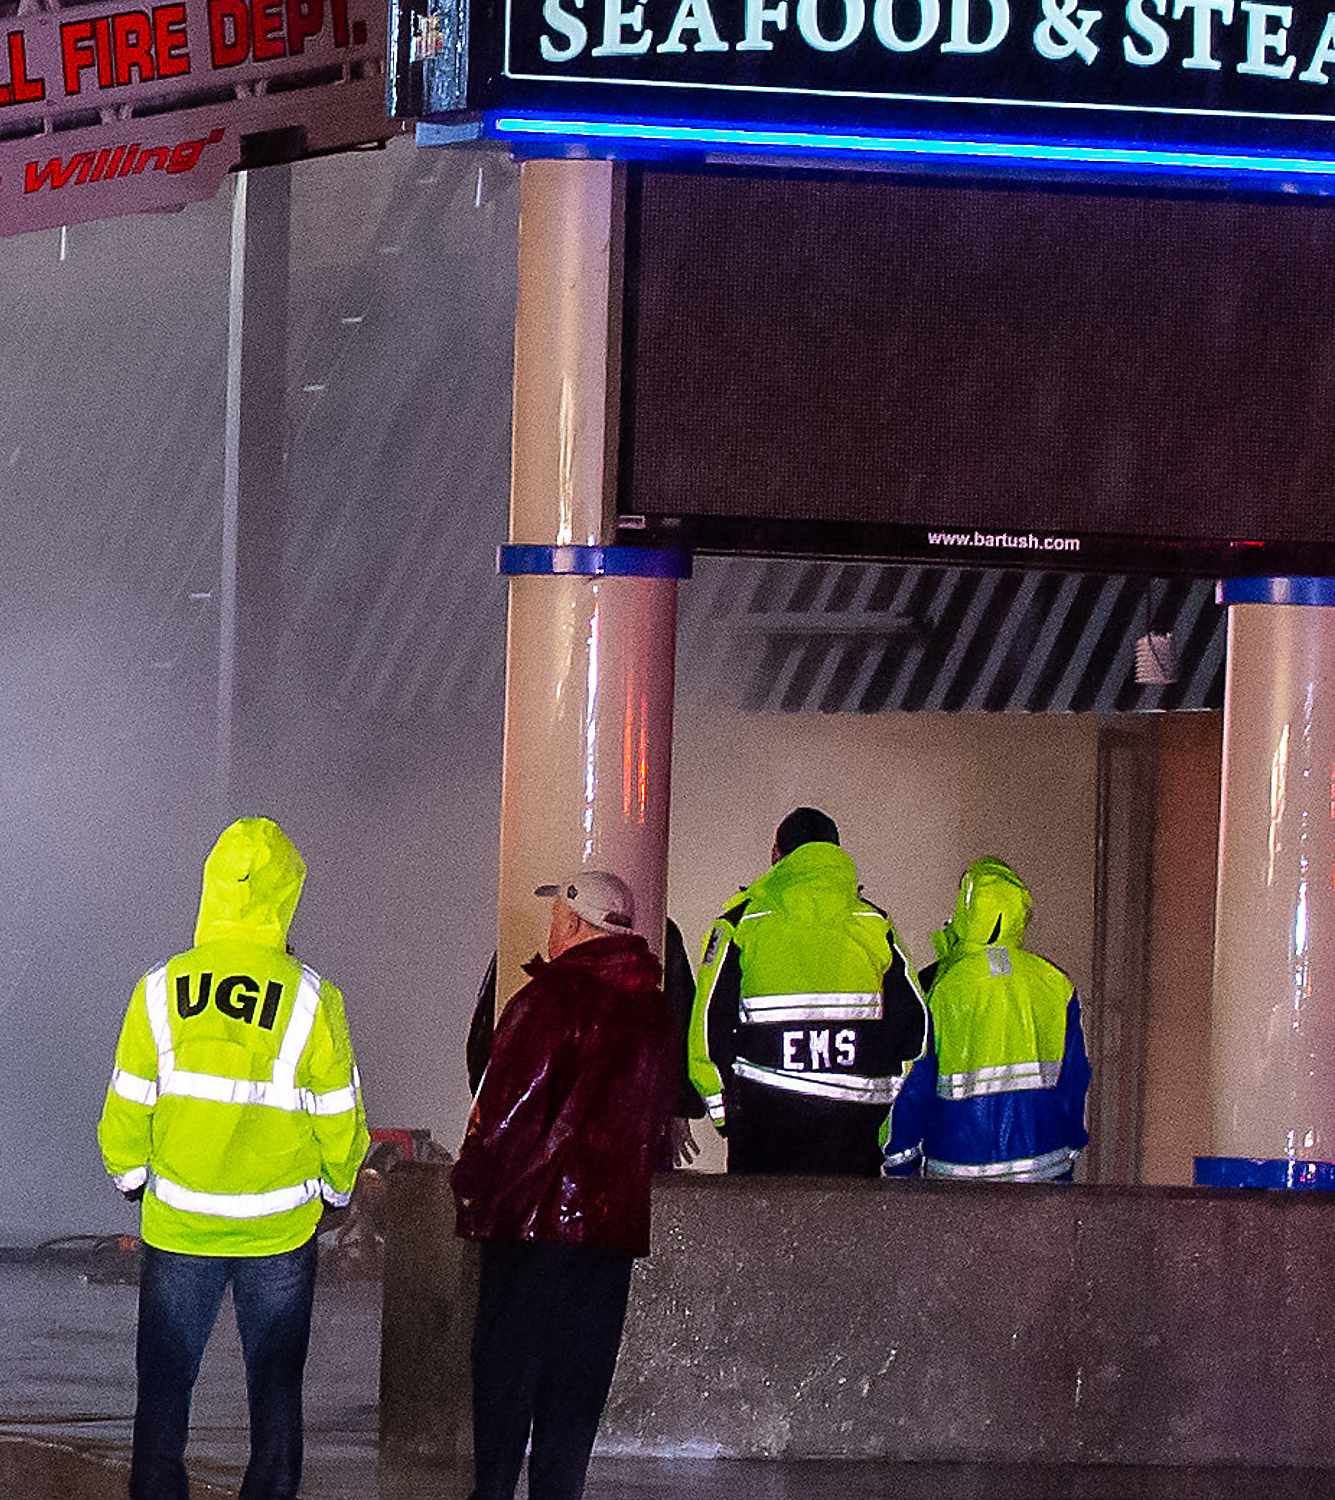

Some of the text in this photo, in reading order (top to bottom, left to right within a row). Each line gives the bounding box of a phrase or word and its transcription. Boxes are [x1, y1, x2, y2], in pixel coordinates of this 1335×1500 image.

[59, 2, 191, 96] FIRE
[23, 127, 226, 195] Willing"
[927, 531, 1081, 551] www.bartush.com
[175, 972, 284, 1031] UGI
[783, 1028, 856, 1071] EMS
